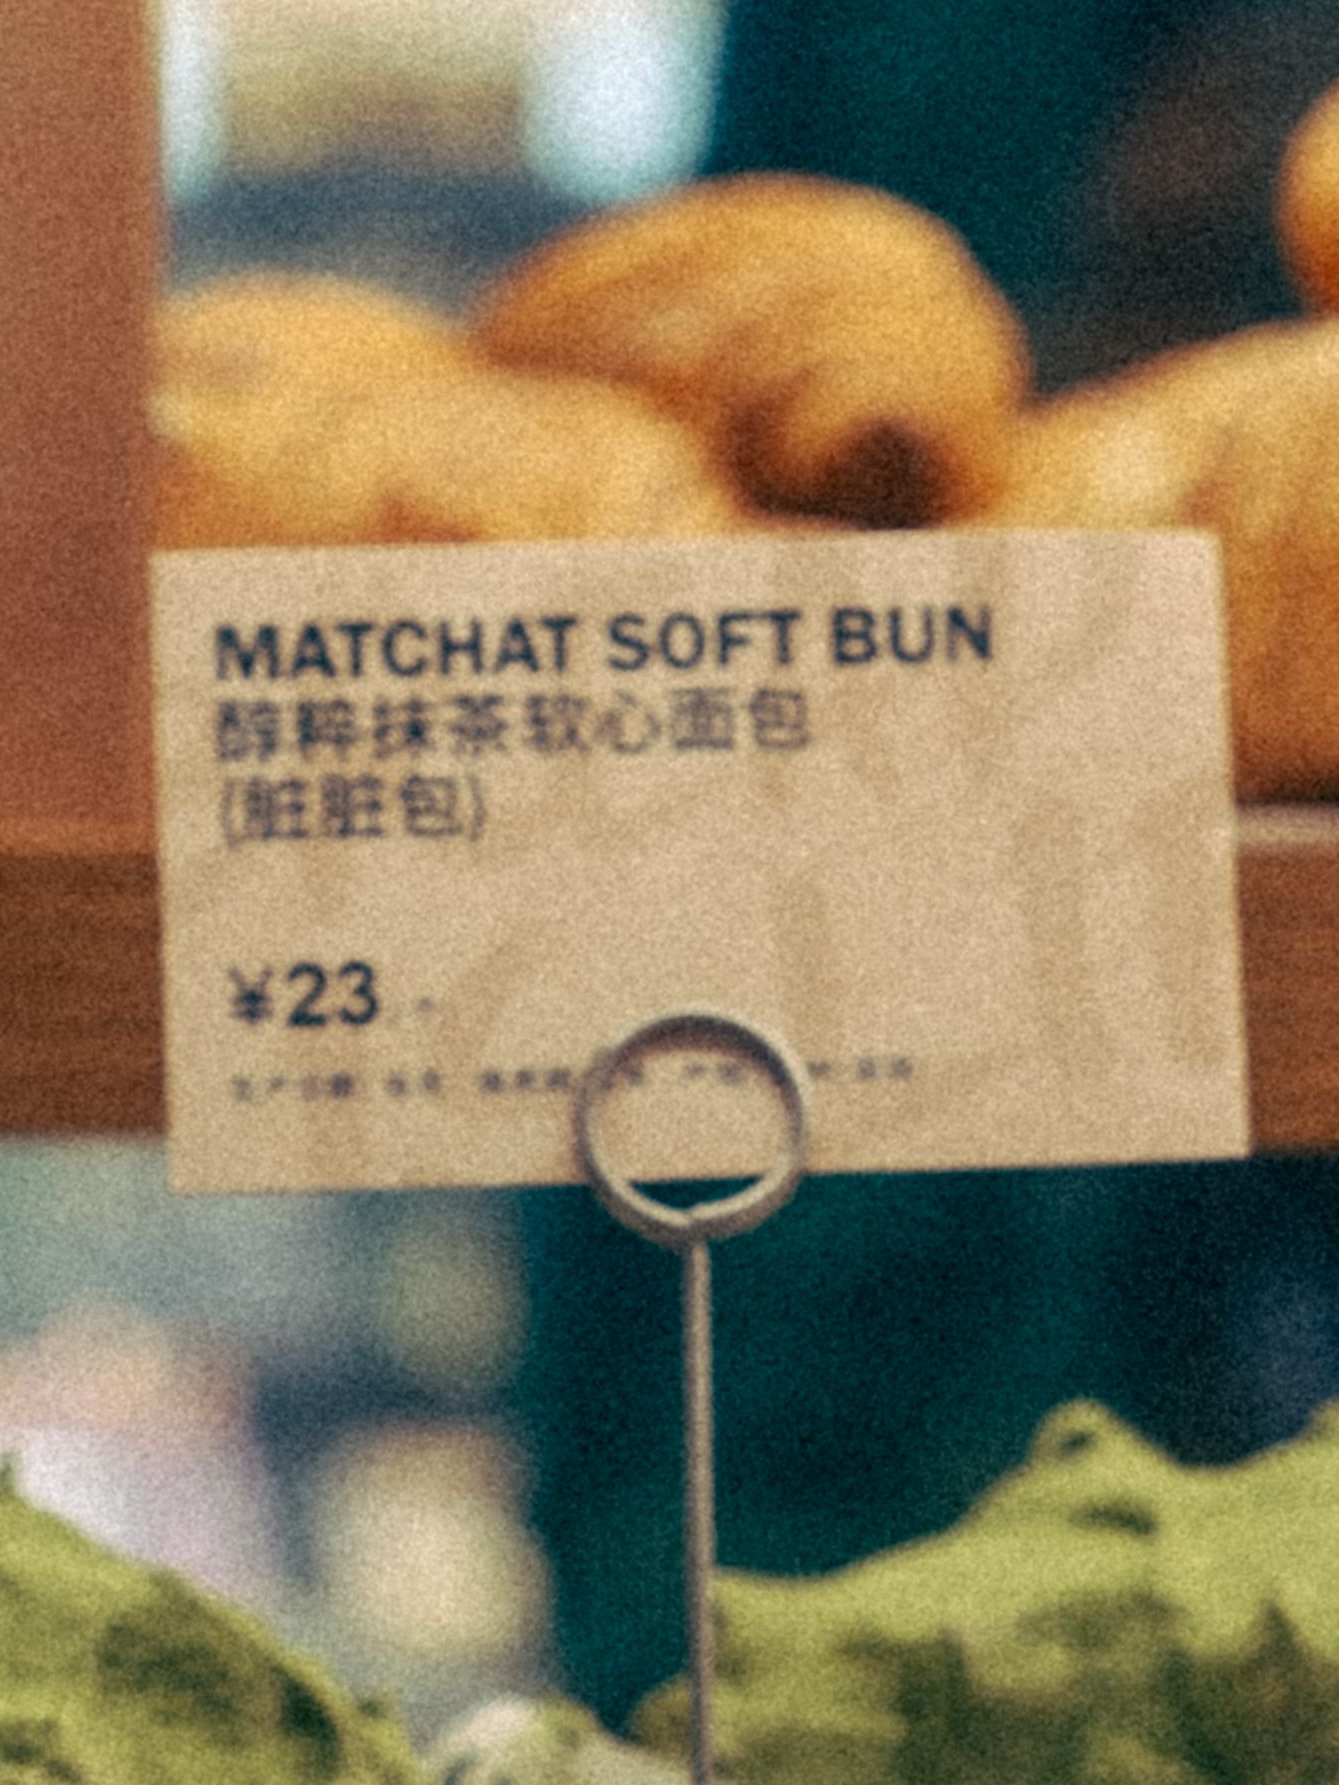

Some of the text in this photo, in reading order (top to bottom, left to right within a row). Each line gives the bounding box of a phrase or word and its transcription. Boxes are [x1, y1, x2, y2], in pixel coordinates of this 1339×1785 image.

[216, 606, 992, 680] MATCHAT SOFT BUN
